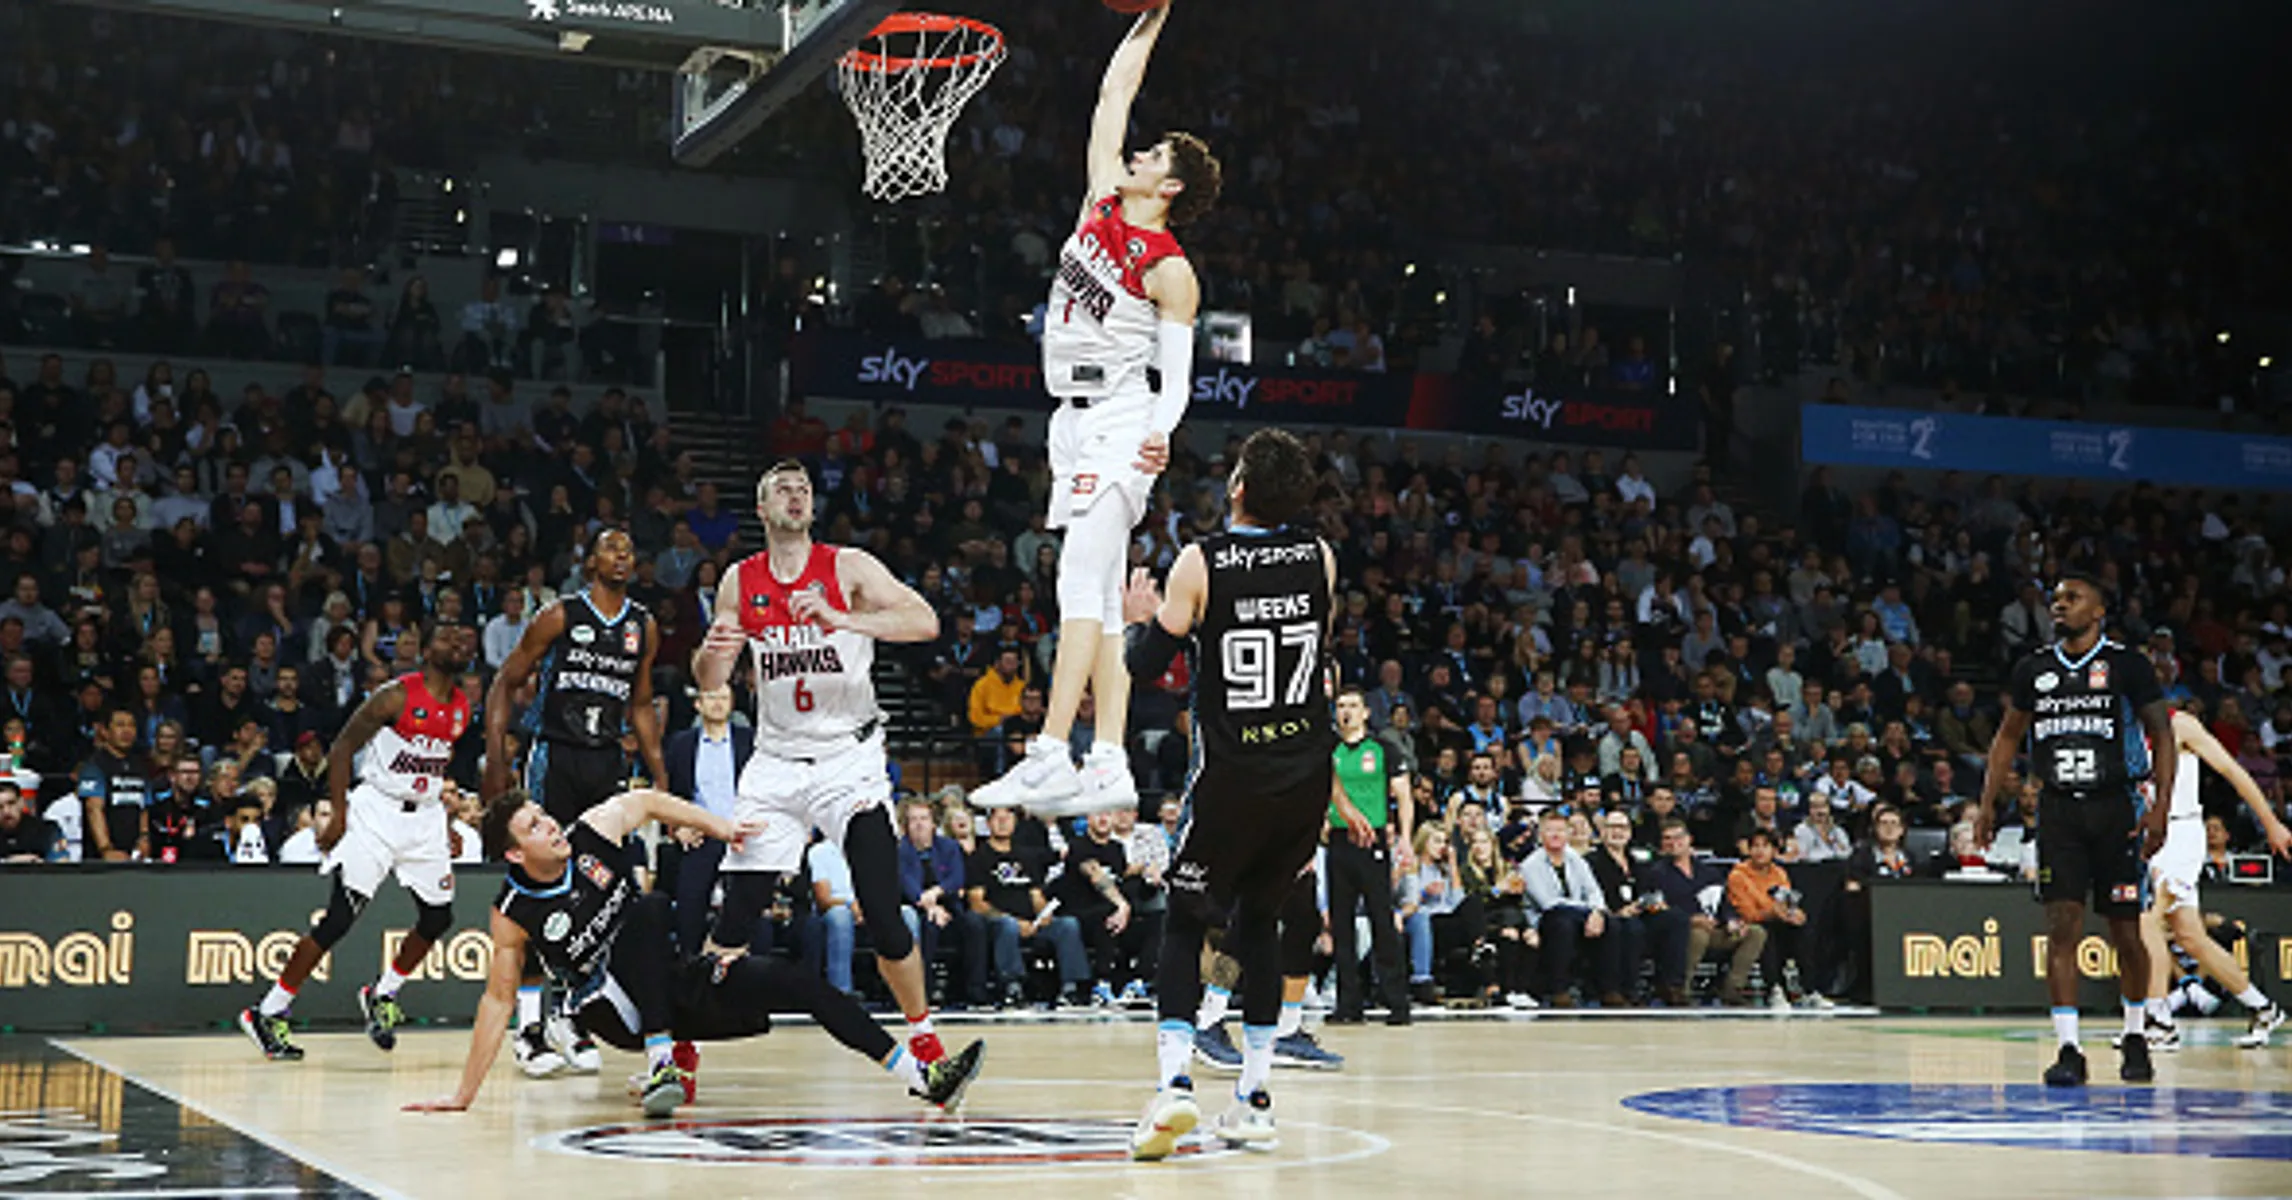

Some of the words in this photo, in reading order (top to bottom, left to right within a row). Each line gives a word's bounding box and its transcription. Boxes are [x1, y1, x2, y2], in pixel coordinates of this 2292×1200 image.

[857, 347, 930, 391] sky
[931, 359, 1039, 390] SPORT
[1193, 367, 1259, 410] sky
[1259, 378, 1359, 405] SPORT
[1501, 387, 1563, 430] sky
[1564, 401, 1654, 432] SPORT
[1234, 593, 1311, 622] WEEKS
[760, 645, 844, 681] HAWKS
[1222, 622, 1319, 710] 97
[794, 677, 814, 713] 6
[2053, 749, 2096, 782] 22
[1903, 917, 2001, 978] mai
